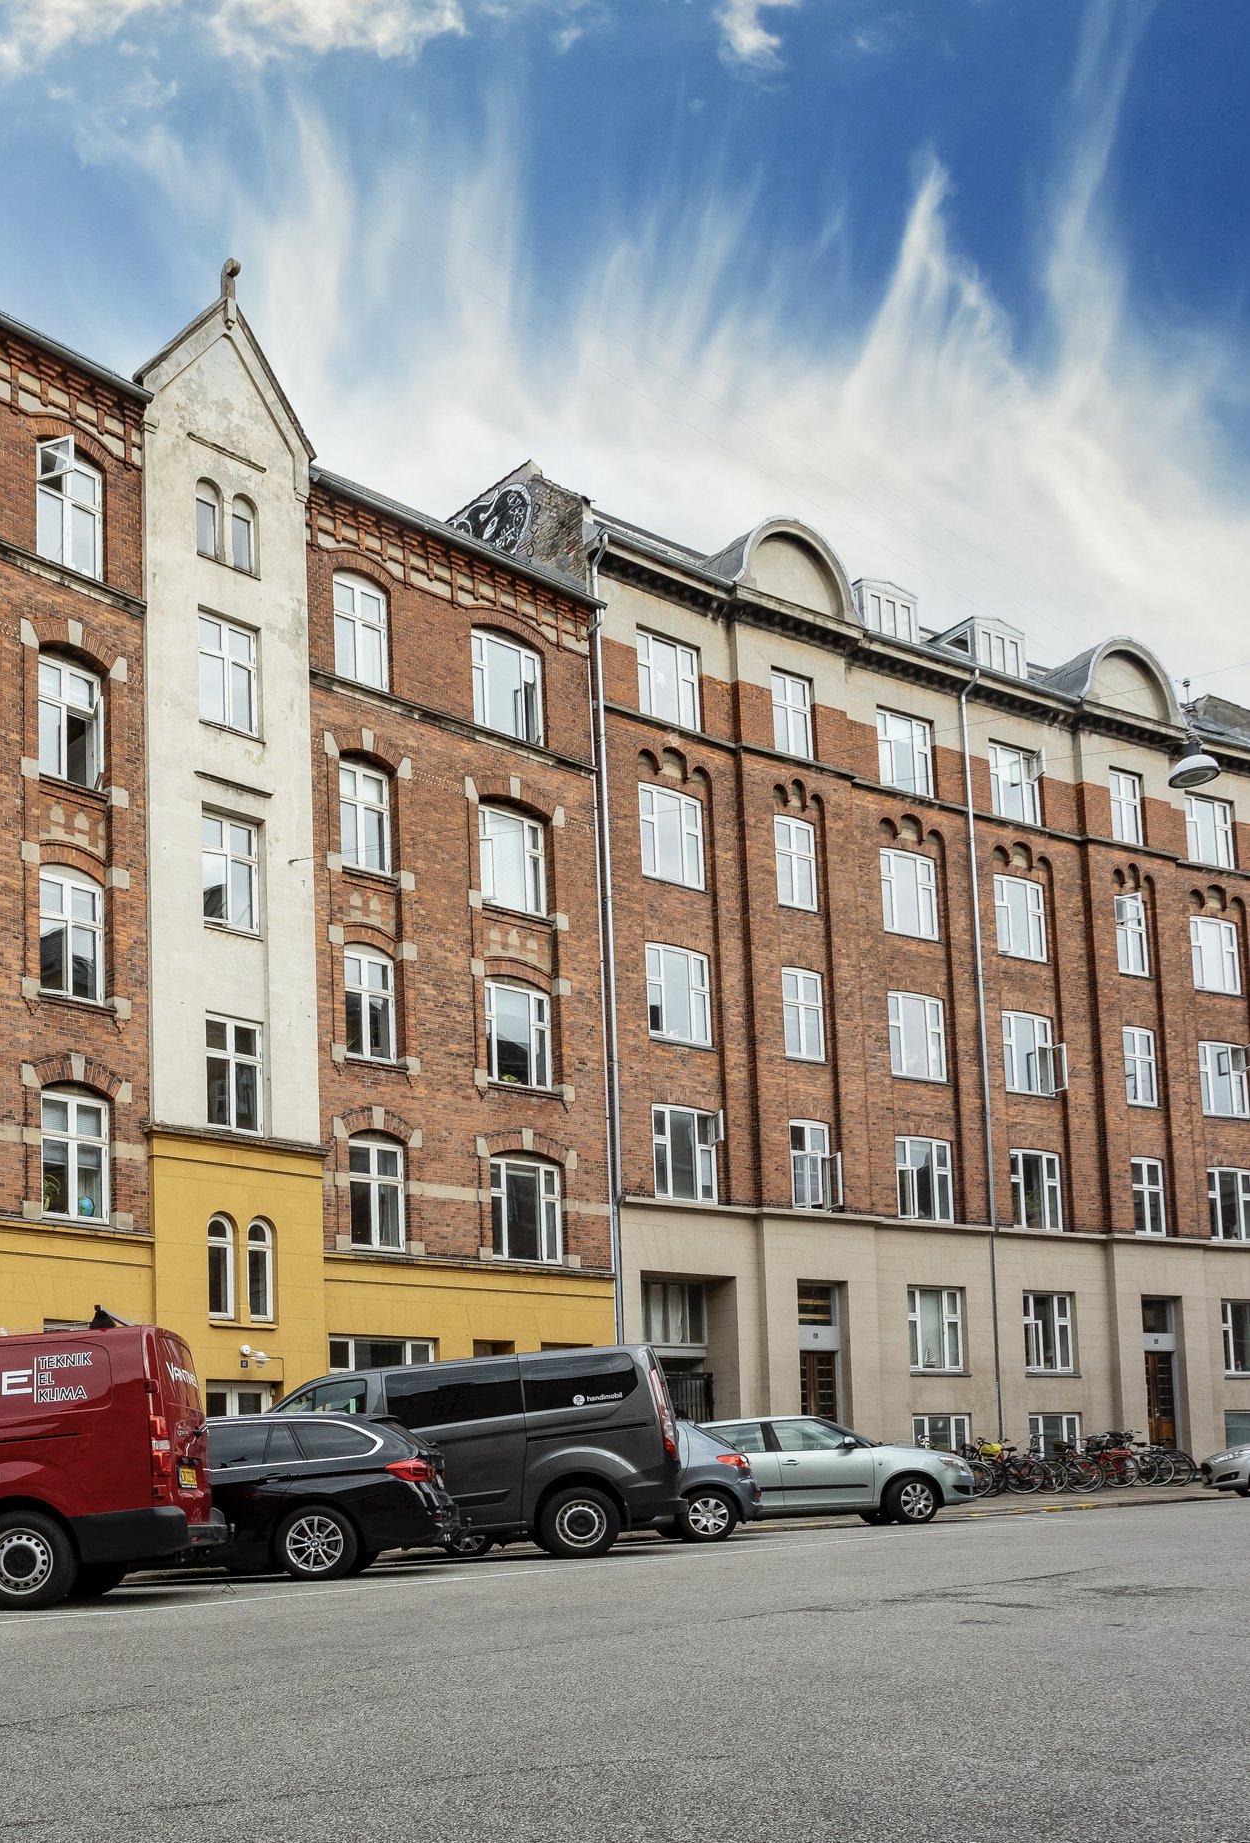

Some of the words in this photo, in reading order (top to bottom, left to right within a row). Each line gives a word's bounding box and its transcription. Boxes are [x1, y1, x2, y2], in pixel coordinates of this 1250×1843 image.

[38, 1351, 93, 1370] TEKNIK
[38, 1371, 55, 1386] EL
[38, 1385, 88, 1403] KLIMA
[586, 1391, 623, 1402] handimobil
